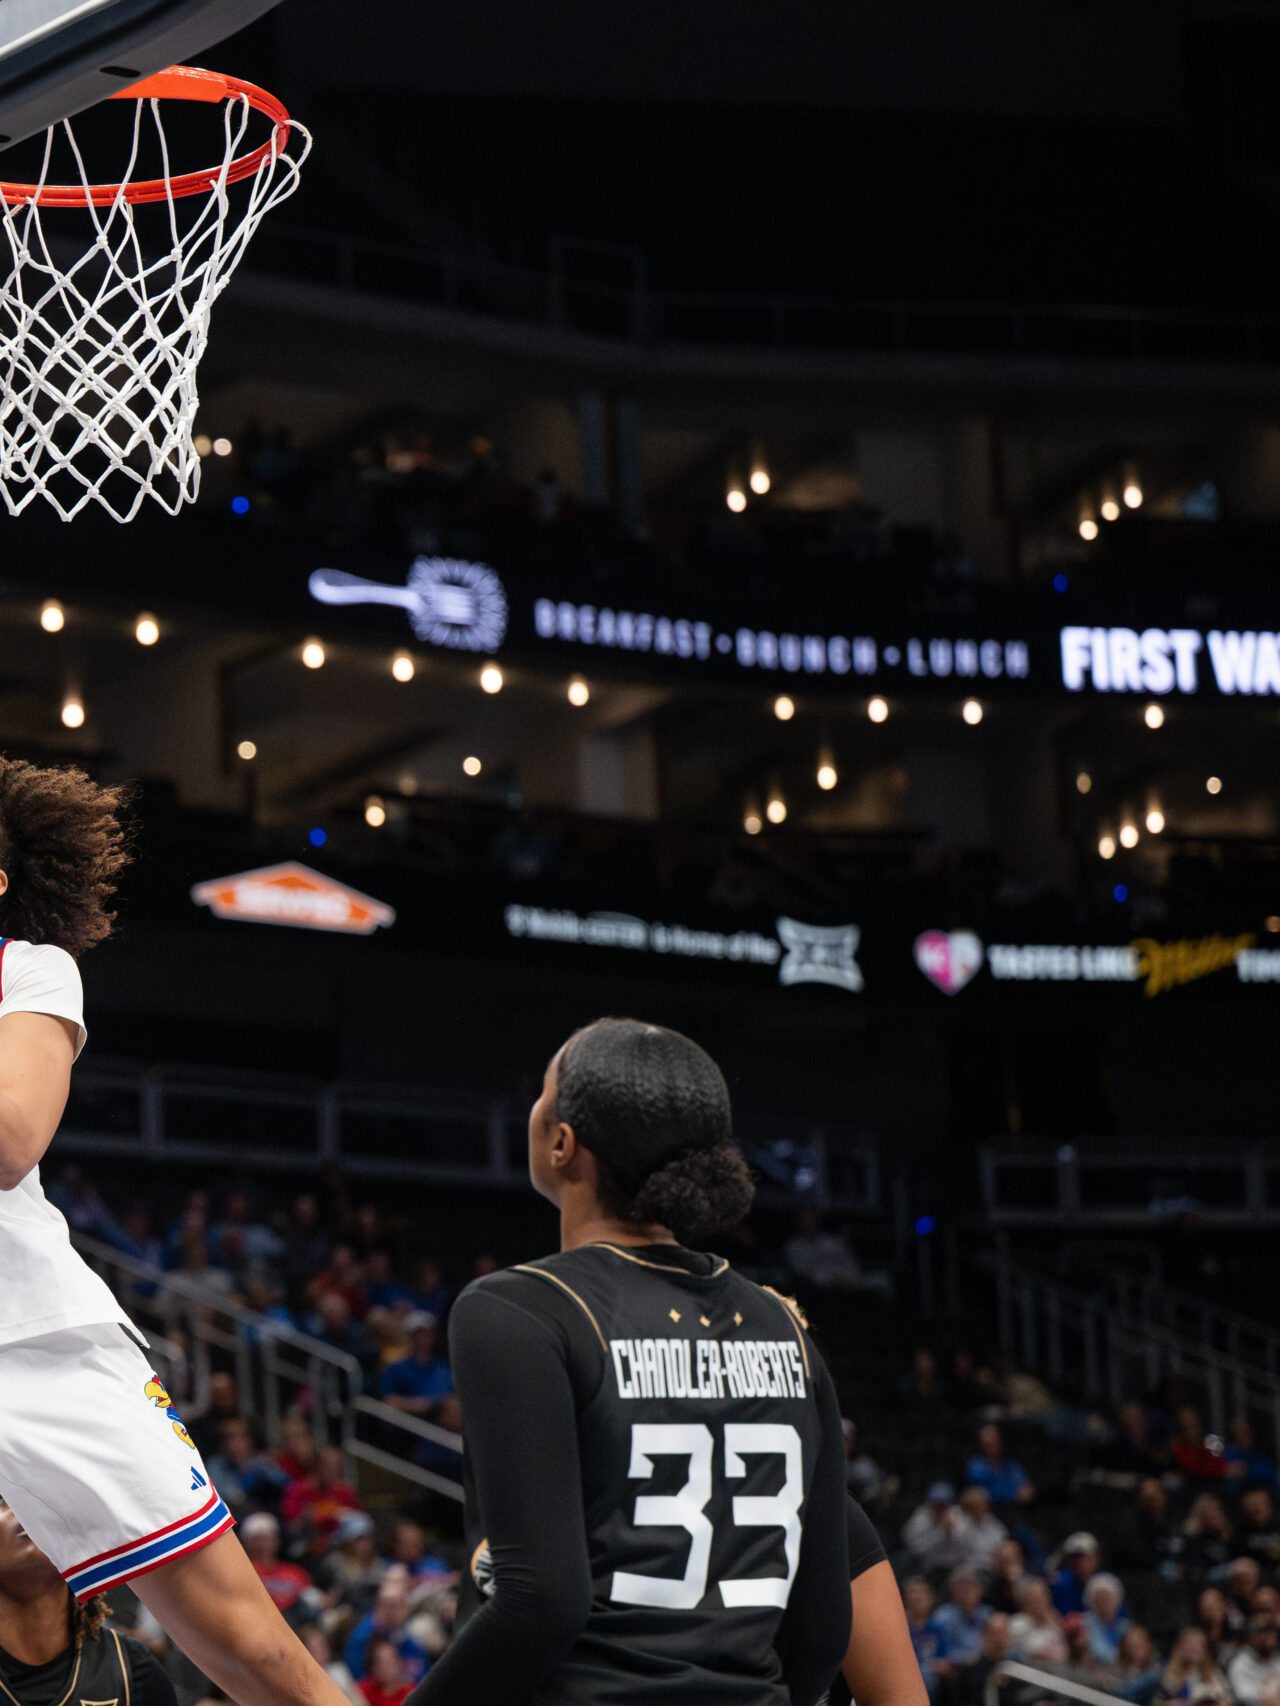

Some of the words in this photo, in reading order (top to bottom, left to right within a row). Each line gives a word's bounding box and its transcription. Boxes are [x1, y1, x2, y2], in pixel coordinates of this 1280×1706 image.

[534, 598, 712, 661] BREAKFAST
[735, 628, 878, 675] BRUNCH
[907, 637, 1030, 679] LUNCH
[1060, 626, 1203, 695] FIRST
[610, 1338, 807, 1399] CHANDLER-ROBERTS
[610, 1423, 804, 1610] 33
